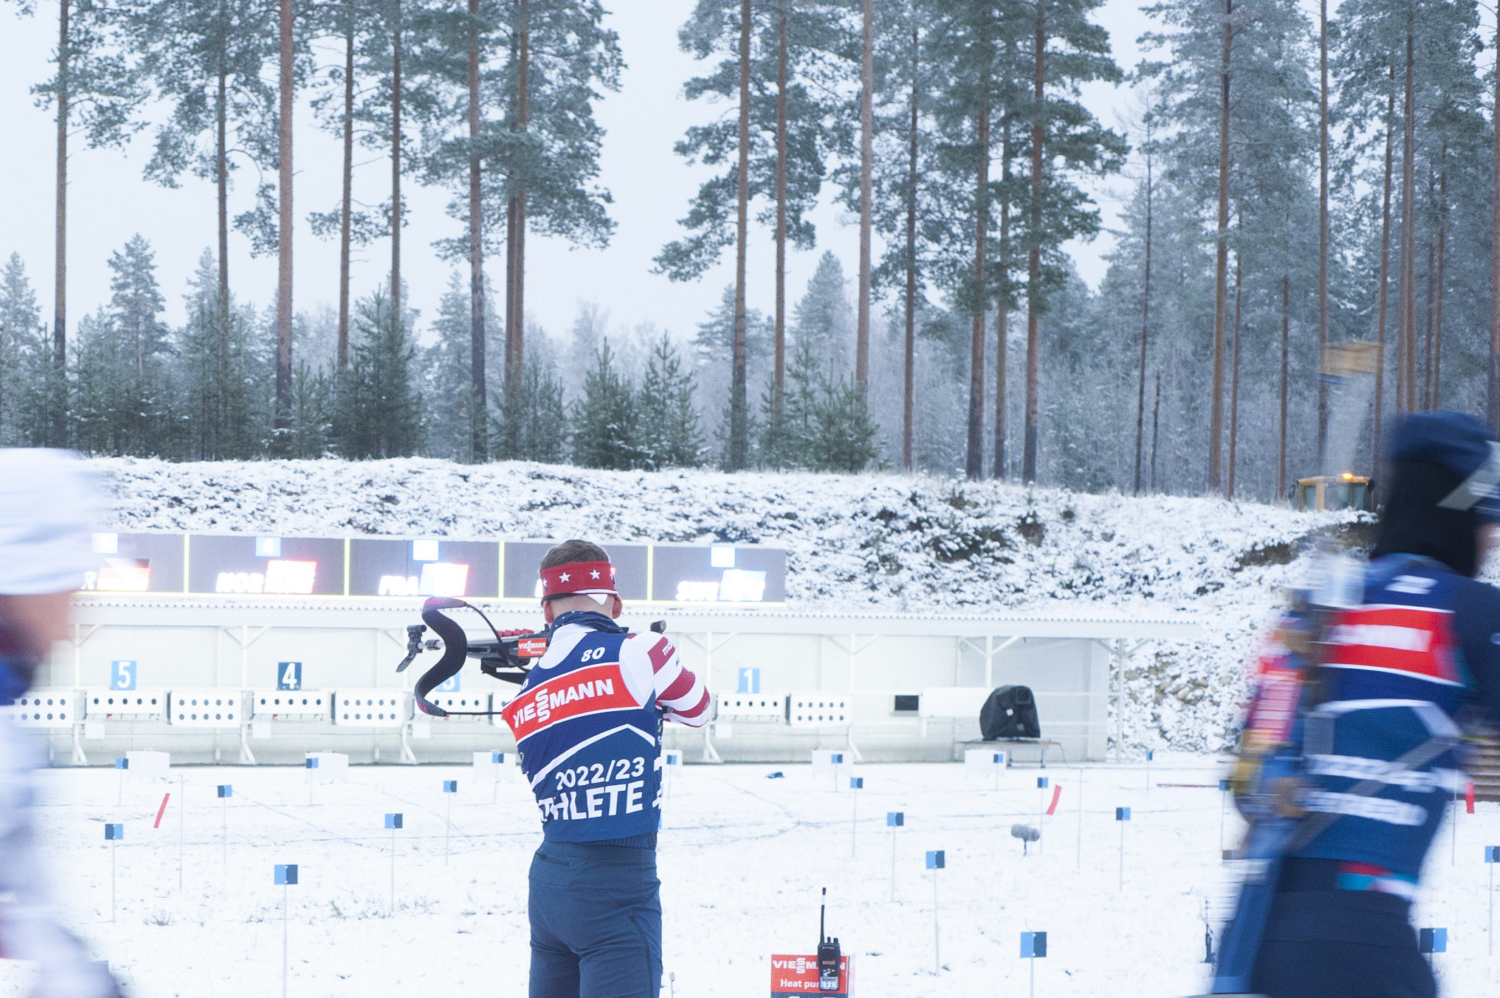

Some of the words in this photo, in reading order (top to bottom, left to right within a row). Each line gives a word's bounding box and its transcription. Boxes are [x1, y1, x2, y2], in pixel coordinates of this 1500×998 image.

[216, 573, 264, 594] NOR
[378, 576, 419, 596] FRA
[580, 646, 606, 663] 80
[117, 662, 131, 689] 5
[282, 663, 298, 689] 4
[744, 669, 754, 692] 1
[512, 678, 615, 728] VIESSMANN
[554, 756, 646, 791] 2022/23
[780, 978, 803, 988] Heat
